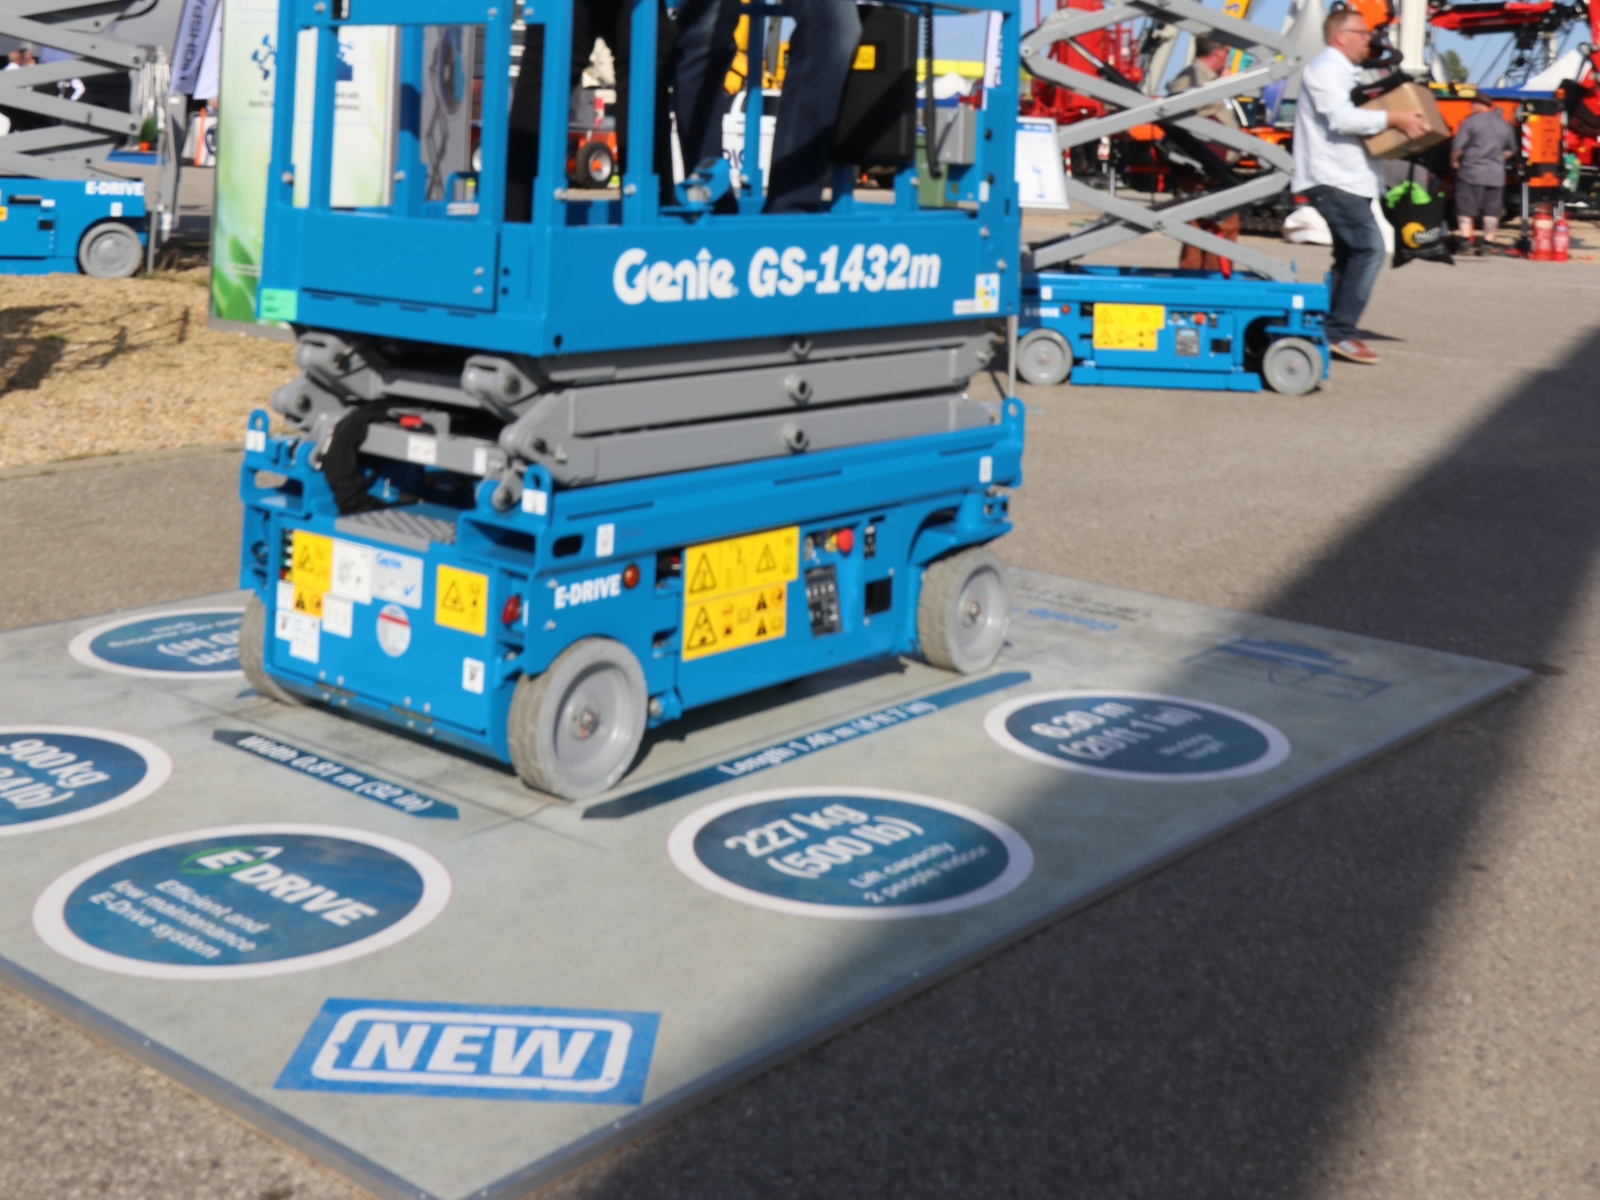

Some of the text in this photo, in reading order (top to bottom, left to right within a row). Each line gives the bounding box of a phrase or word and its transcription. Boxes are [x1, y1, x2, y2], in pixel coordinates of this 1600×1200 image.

[85, 181, 145, 196] E-DRIVE
[613, 243, 941, 305] Genie GS-1432m
[554, 573, 621, 610] E-DRIVE
[724, 803, 869, 857] 227 kg
[766, 836, 873, 879] (500
[110, 879, 256, 952] low maintenance
[223, 911, 271, 935] and
[151, 922, 221, 960] system
[351, 1022, 595, 1078] NEW
